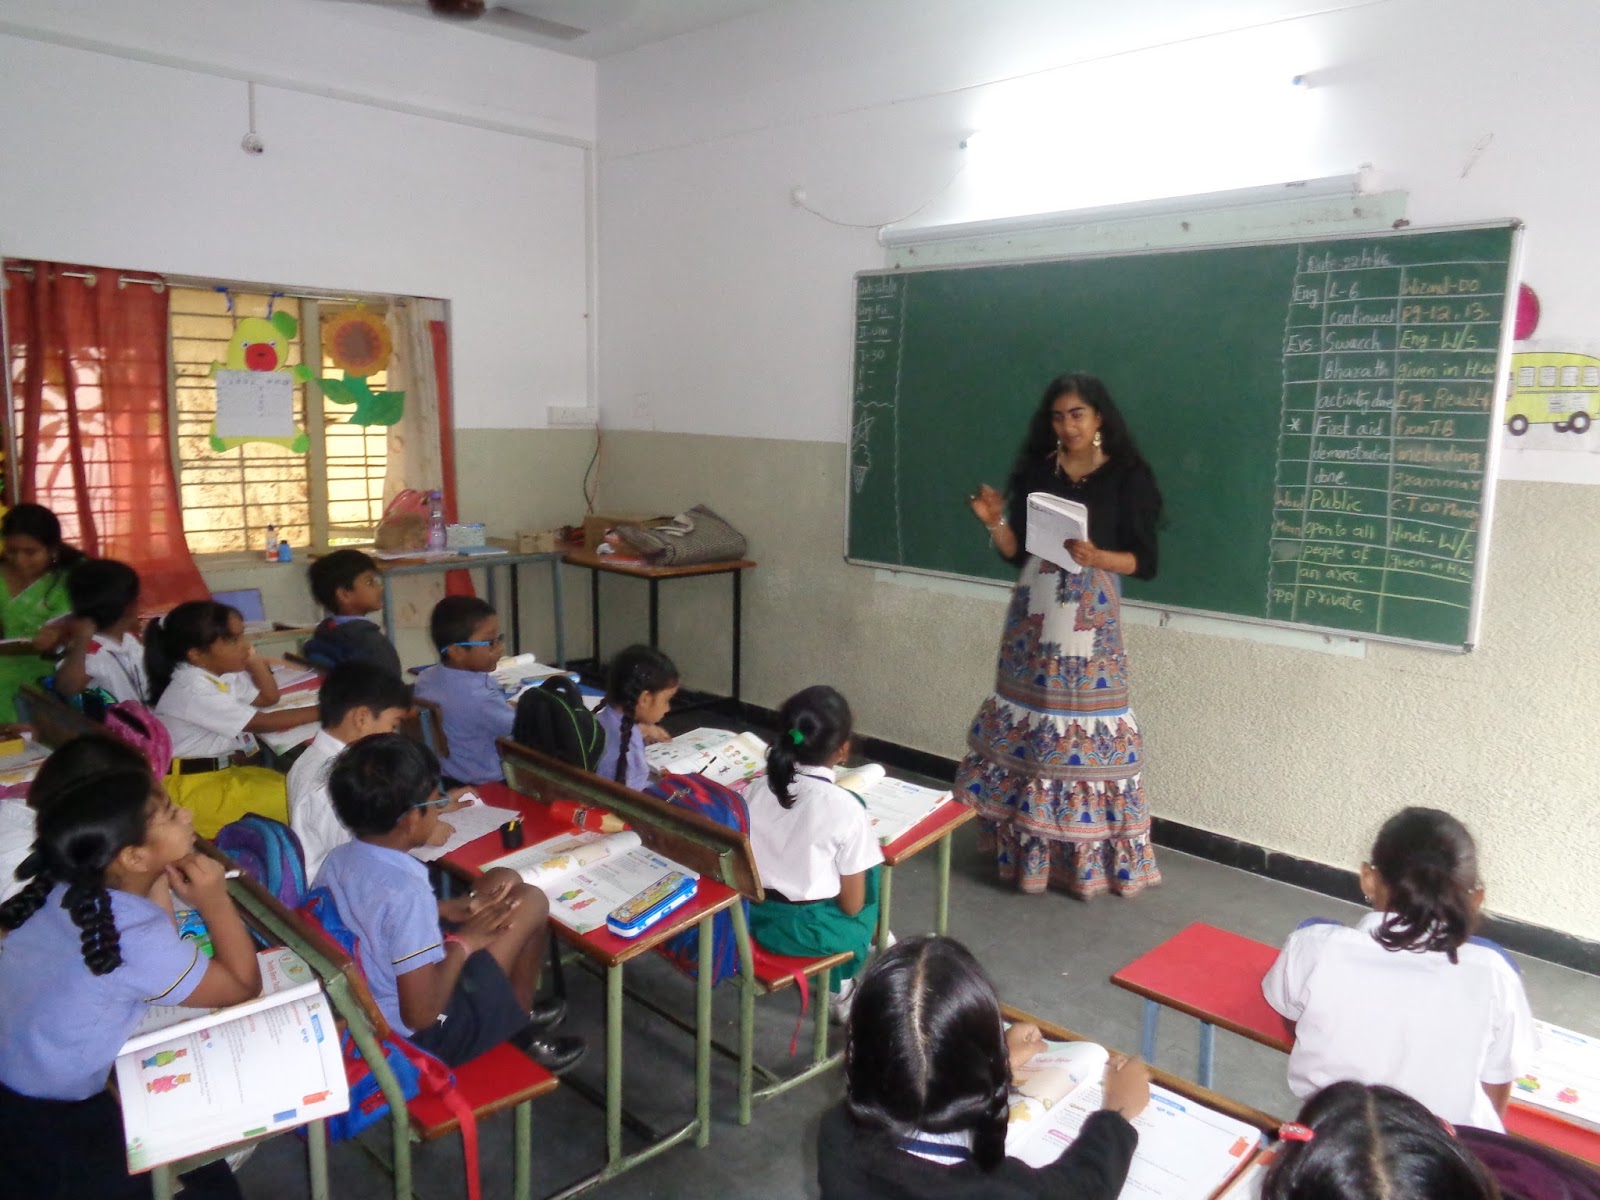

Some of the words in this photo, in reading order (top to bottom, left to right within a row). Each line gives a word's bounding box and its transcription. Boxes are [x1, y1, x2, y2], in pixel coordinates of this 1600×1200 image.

[1293, 285, 1318, 309] Eng
[1314, 415, 1350, 436] First
[1355, 418, 1384, 436] aid
[1310, 489, 1362, 512] Public
[1352, 545, 1371, 564] of
[1300, 567, 1322, 580] an
